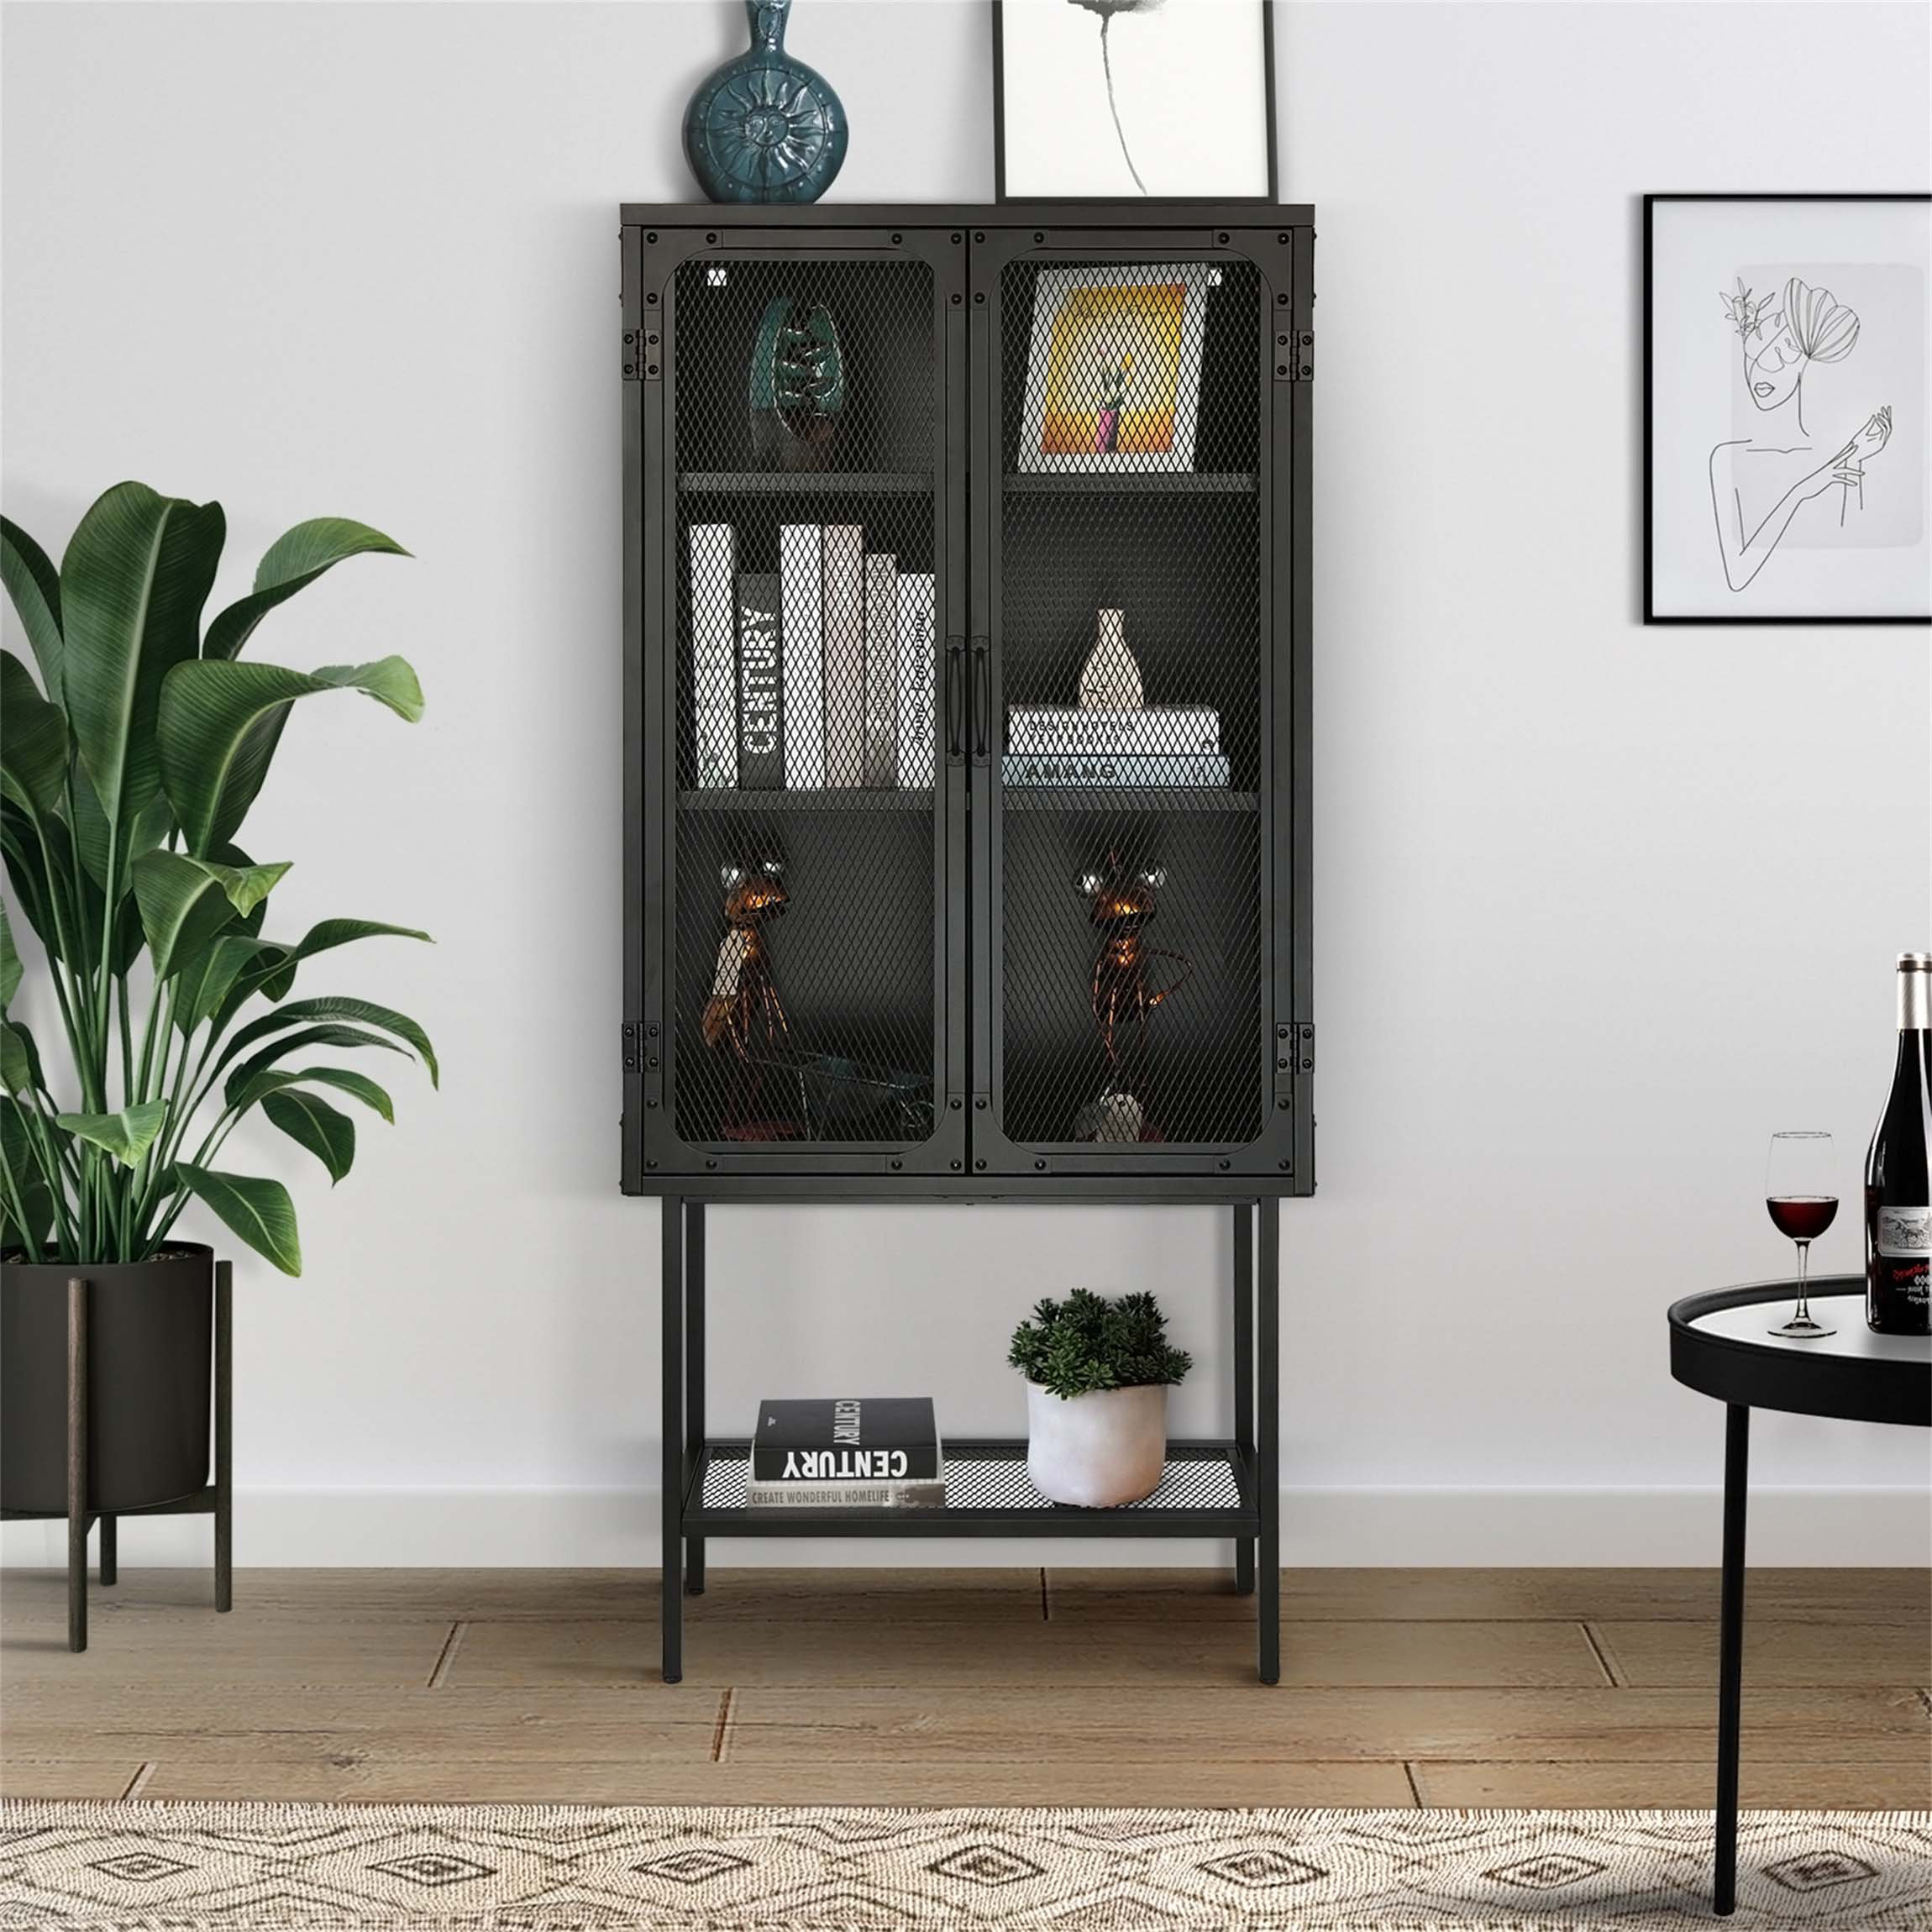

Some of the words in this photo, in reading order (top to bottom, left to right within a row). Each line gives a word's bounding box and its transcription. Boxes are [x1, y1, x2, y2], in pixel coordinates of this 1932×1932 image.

[742, 605, 777, 754] CENTURY
[832, 1400, 861, 1446] CENTURY
[782, 1450, 908, 1478] CENTURY
[752, 1492, 784, 1504] CREATE
[786, 1491, 842, 1504] WONDERFUL
[845, 1490, 890, 1503] HOMELIFE
